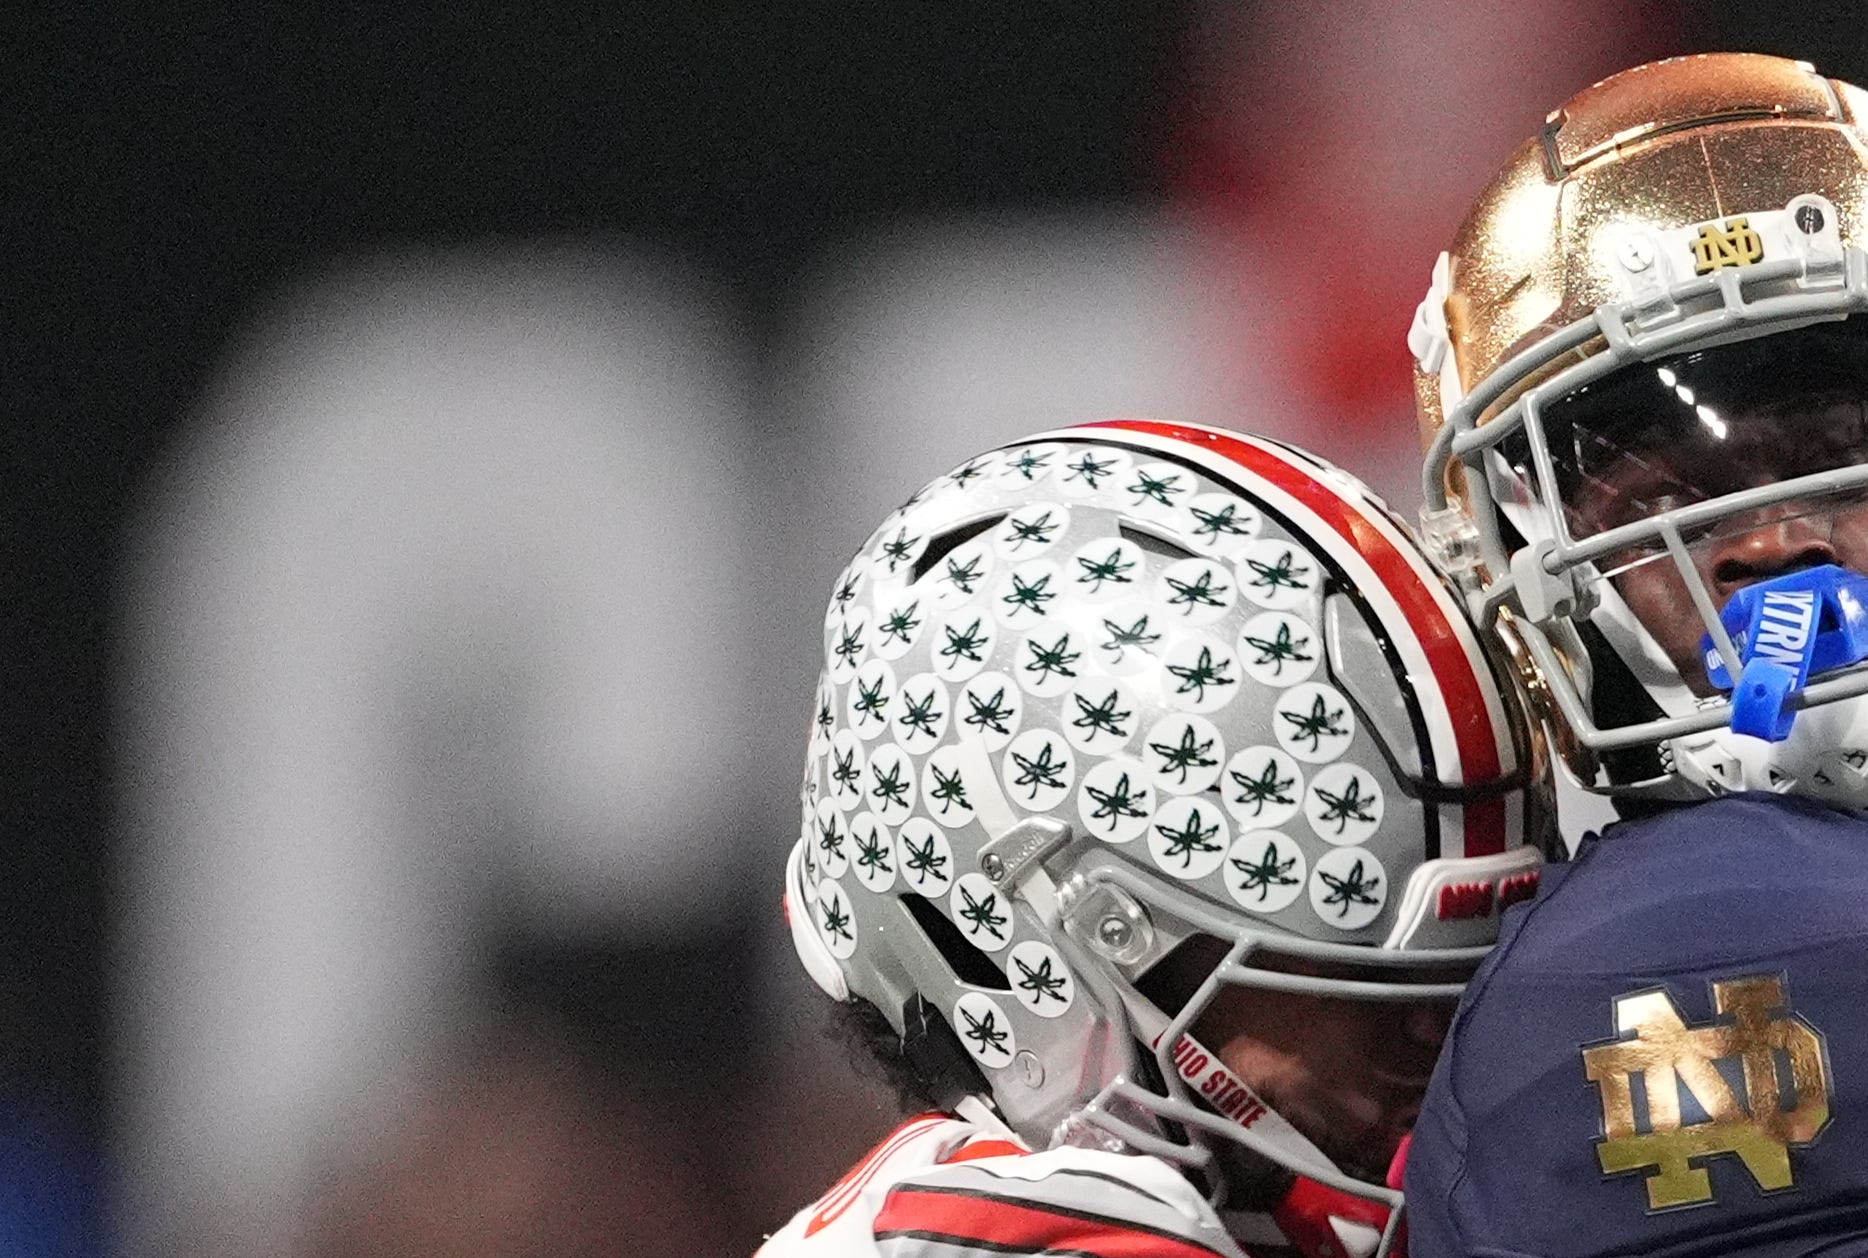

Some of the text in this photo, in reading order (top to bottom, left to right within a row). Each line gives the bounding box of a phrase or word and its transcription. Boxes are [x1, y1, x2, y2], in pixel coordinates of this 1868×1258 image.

[1689, 217, 1764, 276] ND
[1152, 1027, 1268, 1129] HIO STATE
[1580, 973, 1832, 1210] ND
